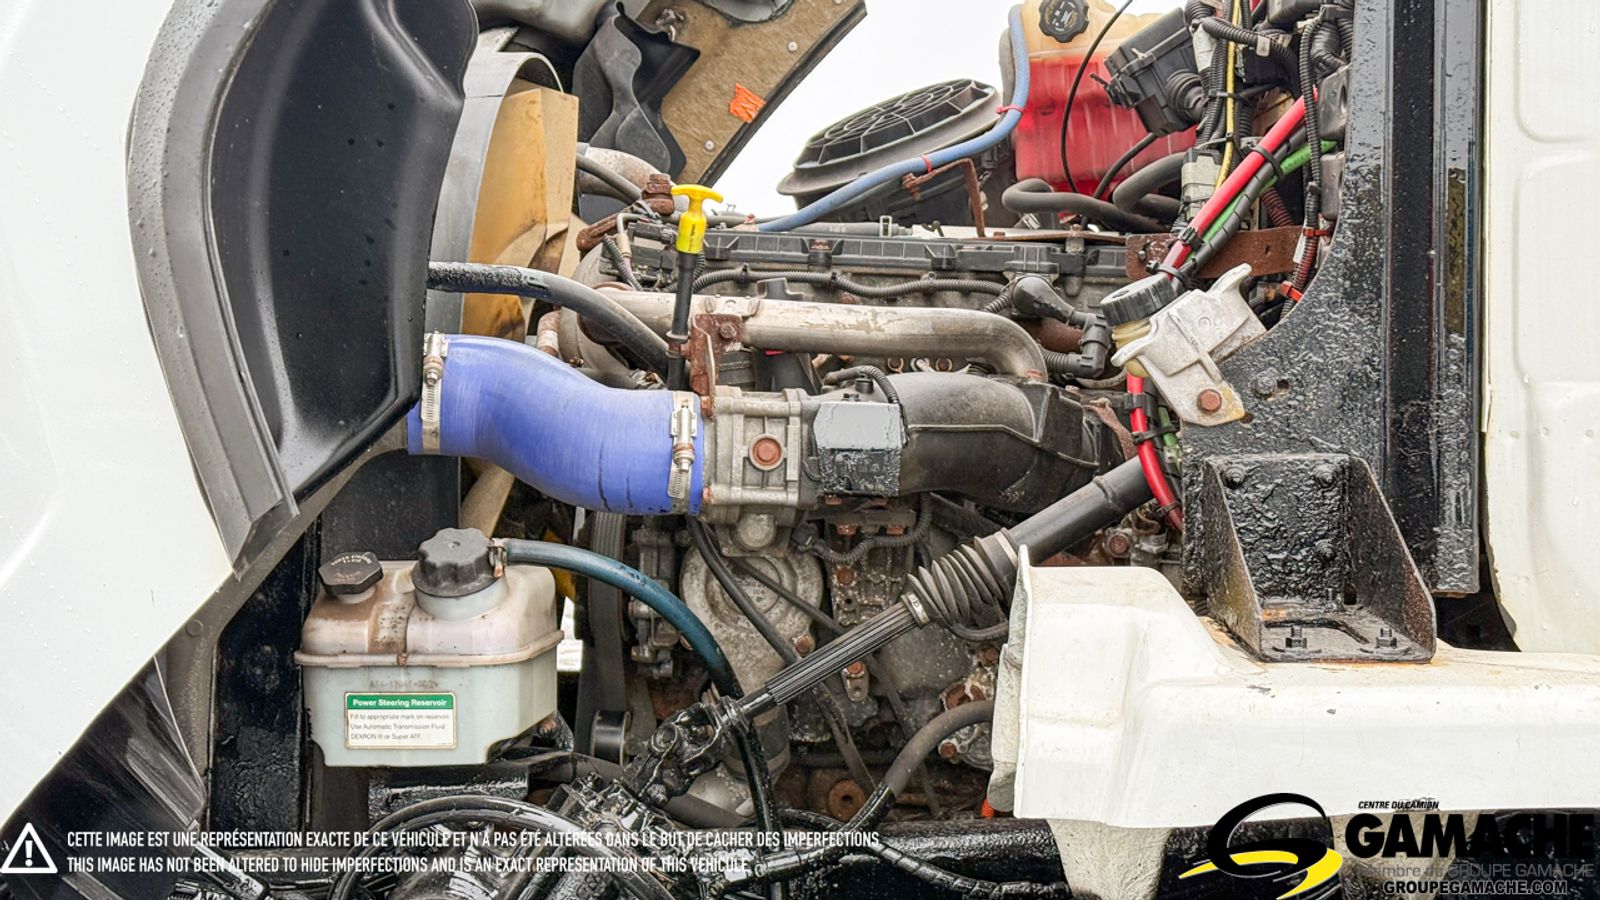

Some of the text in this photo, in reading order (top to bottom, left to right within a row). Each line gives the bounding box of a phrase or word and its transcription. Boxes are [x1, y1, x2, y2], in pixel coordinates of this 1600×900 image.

[352, 698, 448, 708] Power Steering Reservoir
